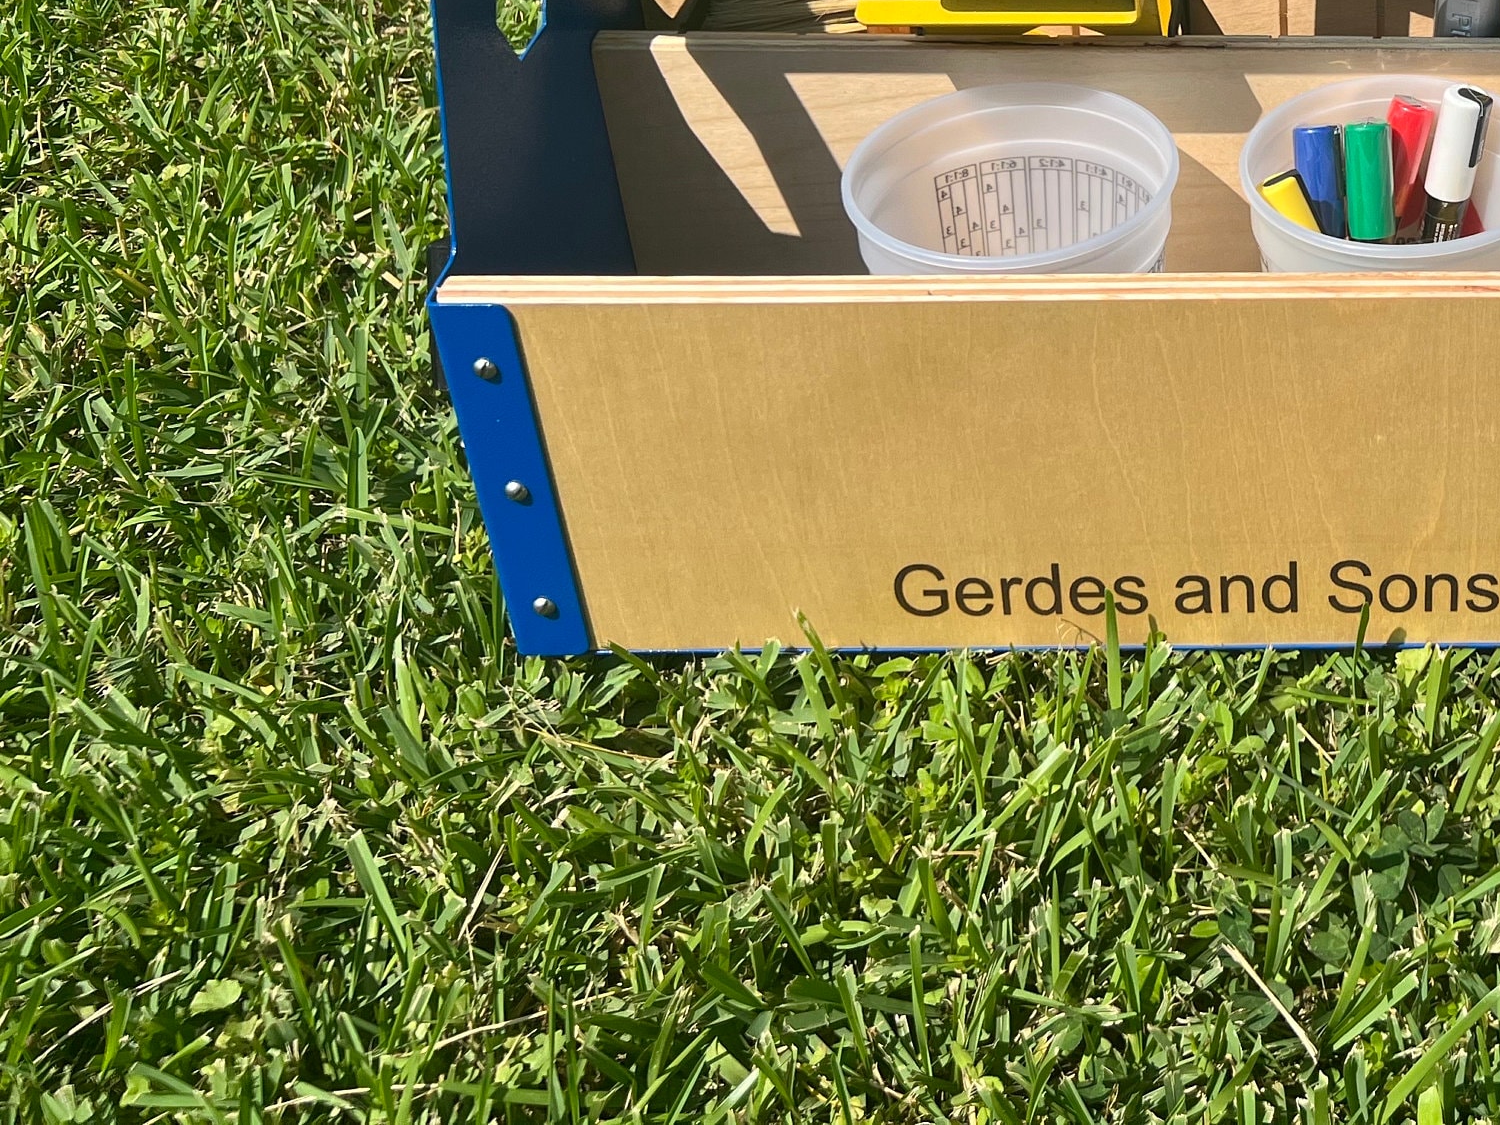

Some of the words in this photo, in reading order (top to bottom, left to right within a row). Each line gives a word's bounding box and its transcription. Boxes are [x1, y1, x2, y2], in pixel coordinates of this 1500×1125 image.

[893, 562, 1149, 617] Gerdes
[1175, 561, 1298, 615] and
[1328, 559, 1500, 615] Sons
